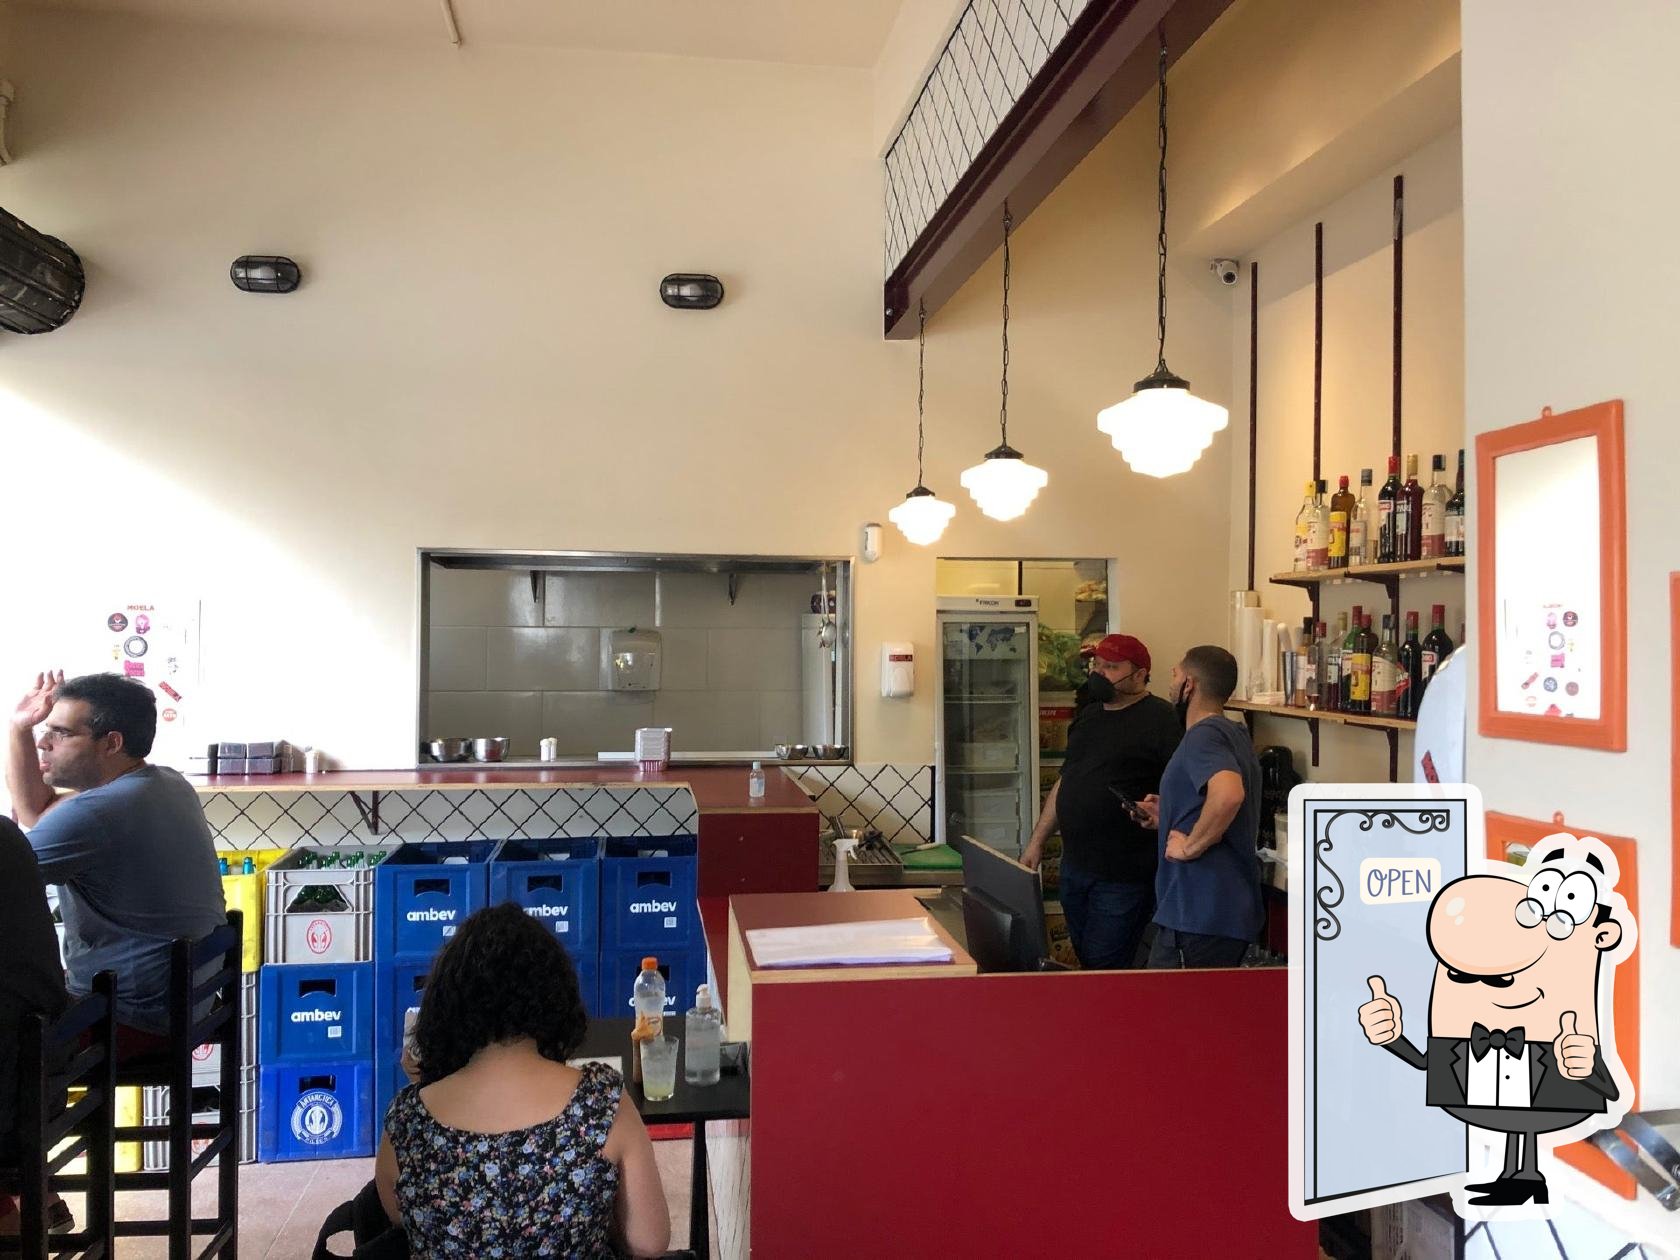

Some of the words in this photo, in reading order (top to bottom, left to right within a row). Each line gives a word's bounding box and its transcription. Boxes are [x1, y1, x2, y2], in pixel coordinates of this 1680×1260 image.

[629, 899, 677, 913] ambev
[407, 907, 456, 921] ambev
[291, 1008, 341, 1024] ambev
